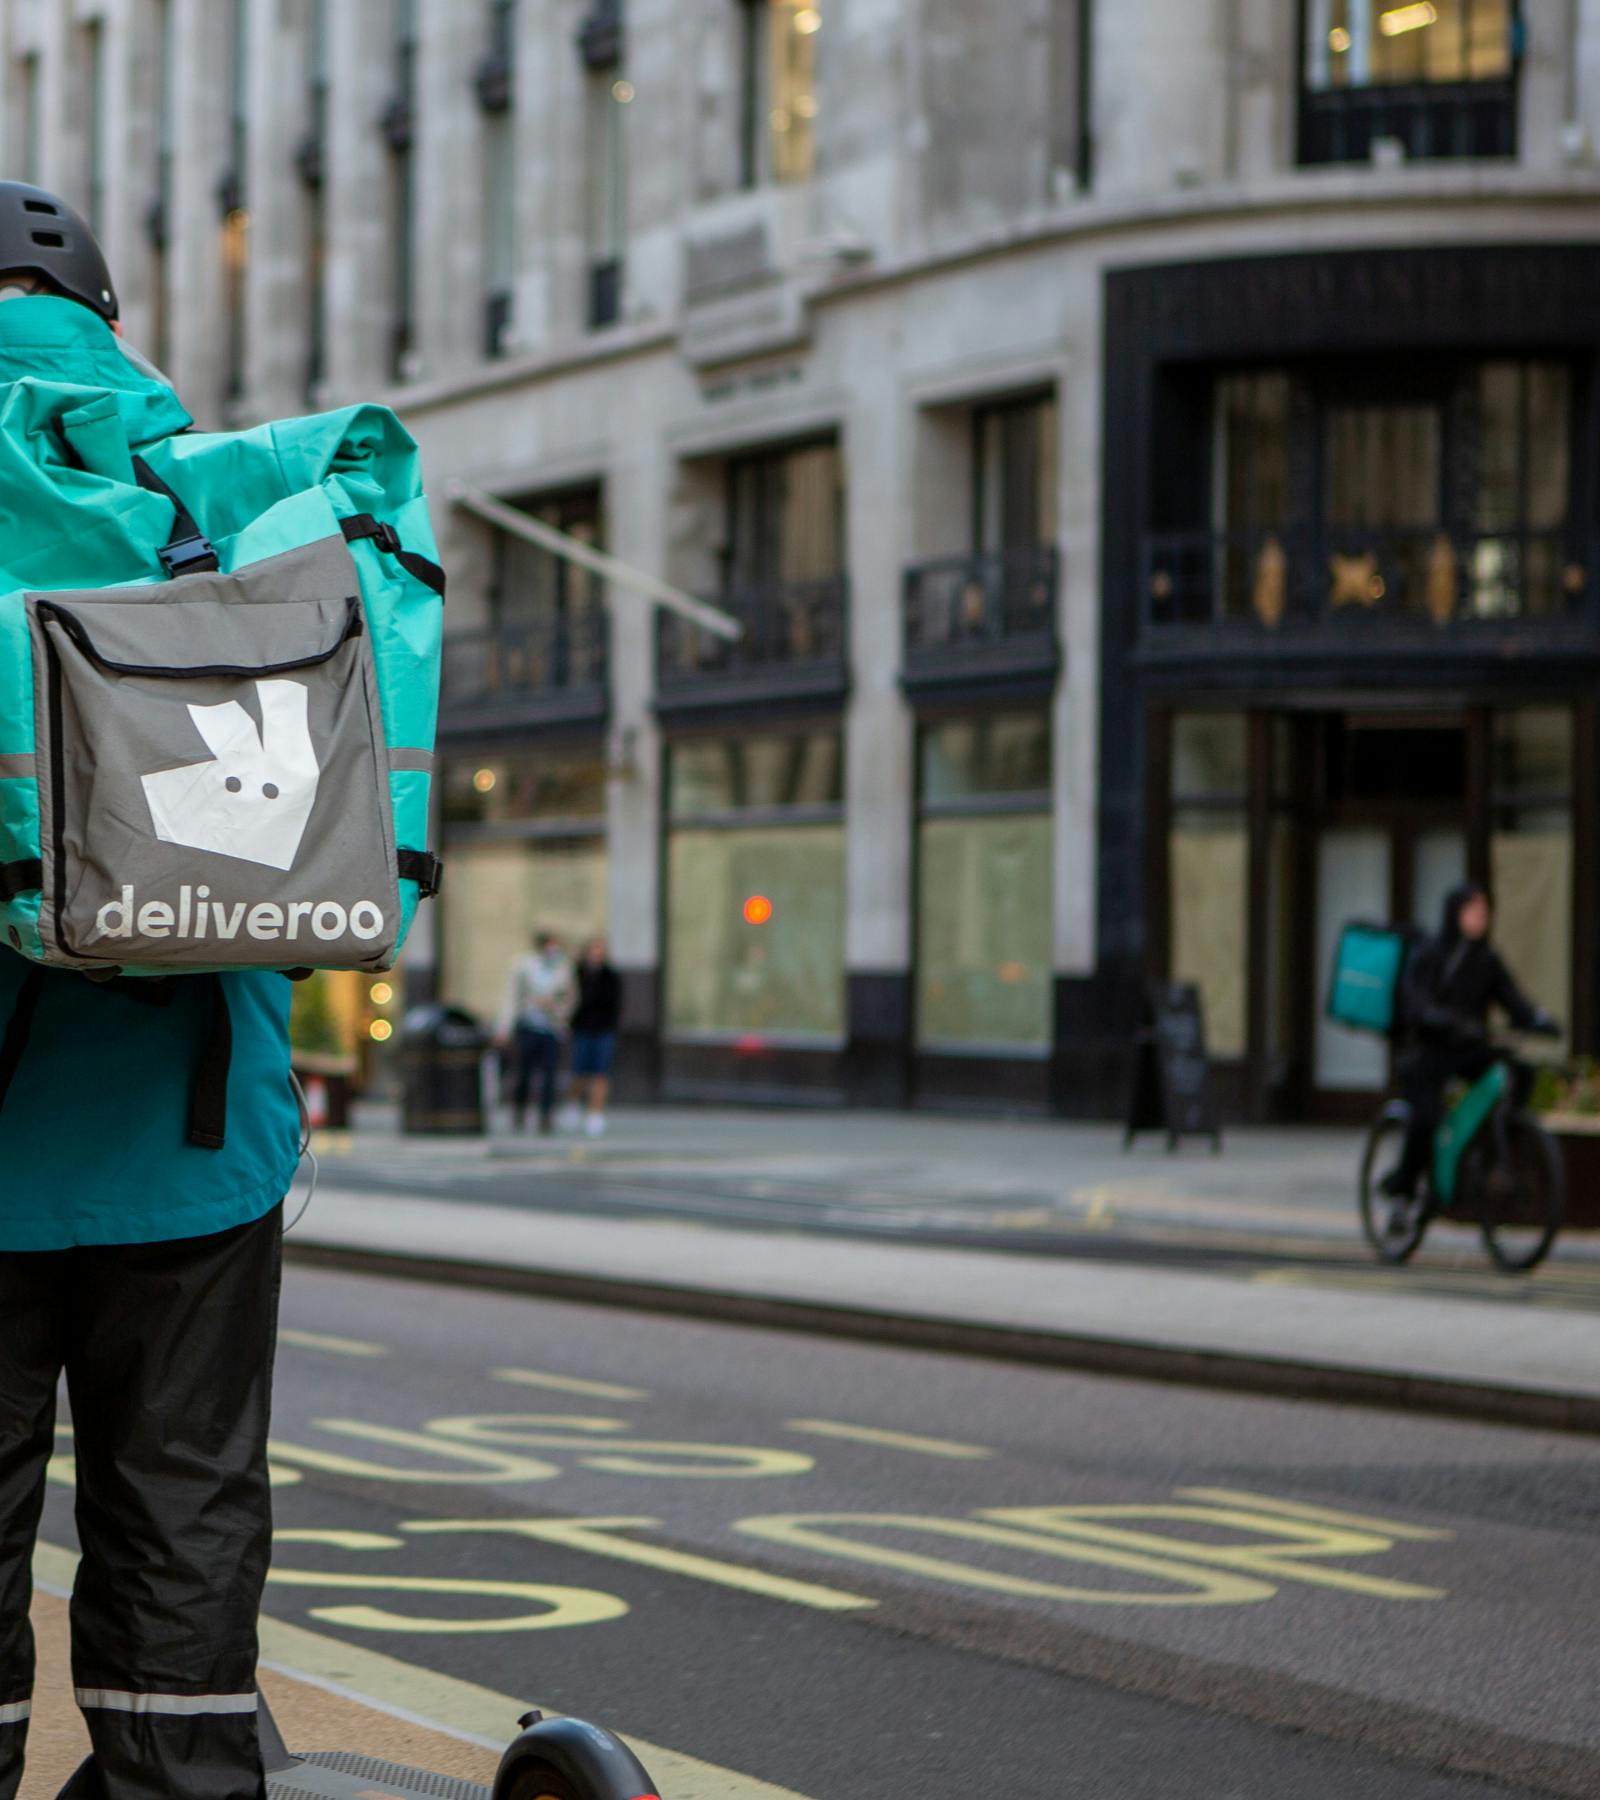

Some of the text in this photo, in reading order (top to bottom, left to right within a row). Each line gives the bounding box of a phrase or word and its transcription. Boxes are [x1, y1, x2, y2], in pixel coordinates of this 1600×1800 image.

[96, 884, 385, 941] deliveroo
[46, 1413, 816, 1484] US
[266, 1502, 1448, 1632] STOP
